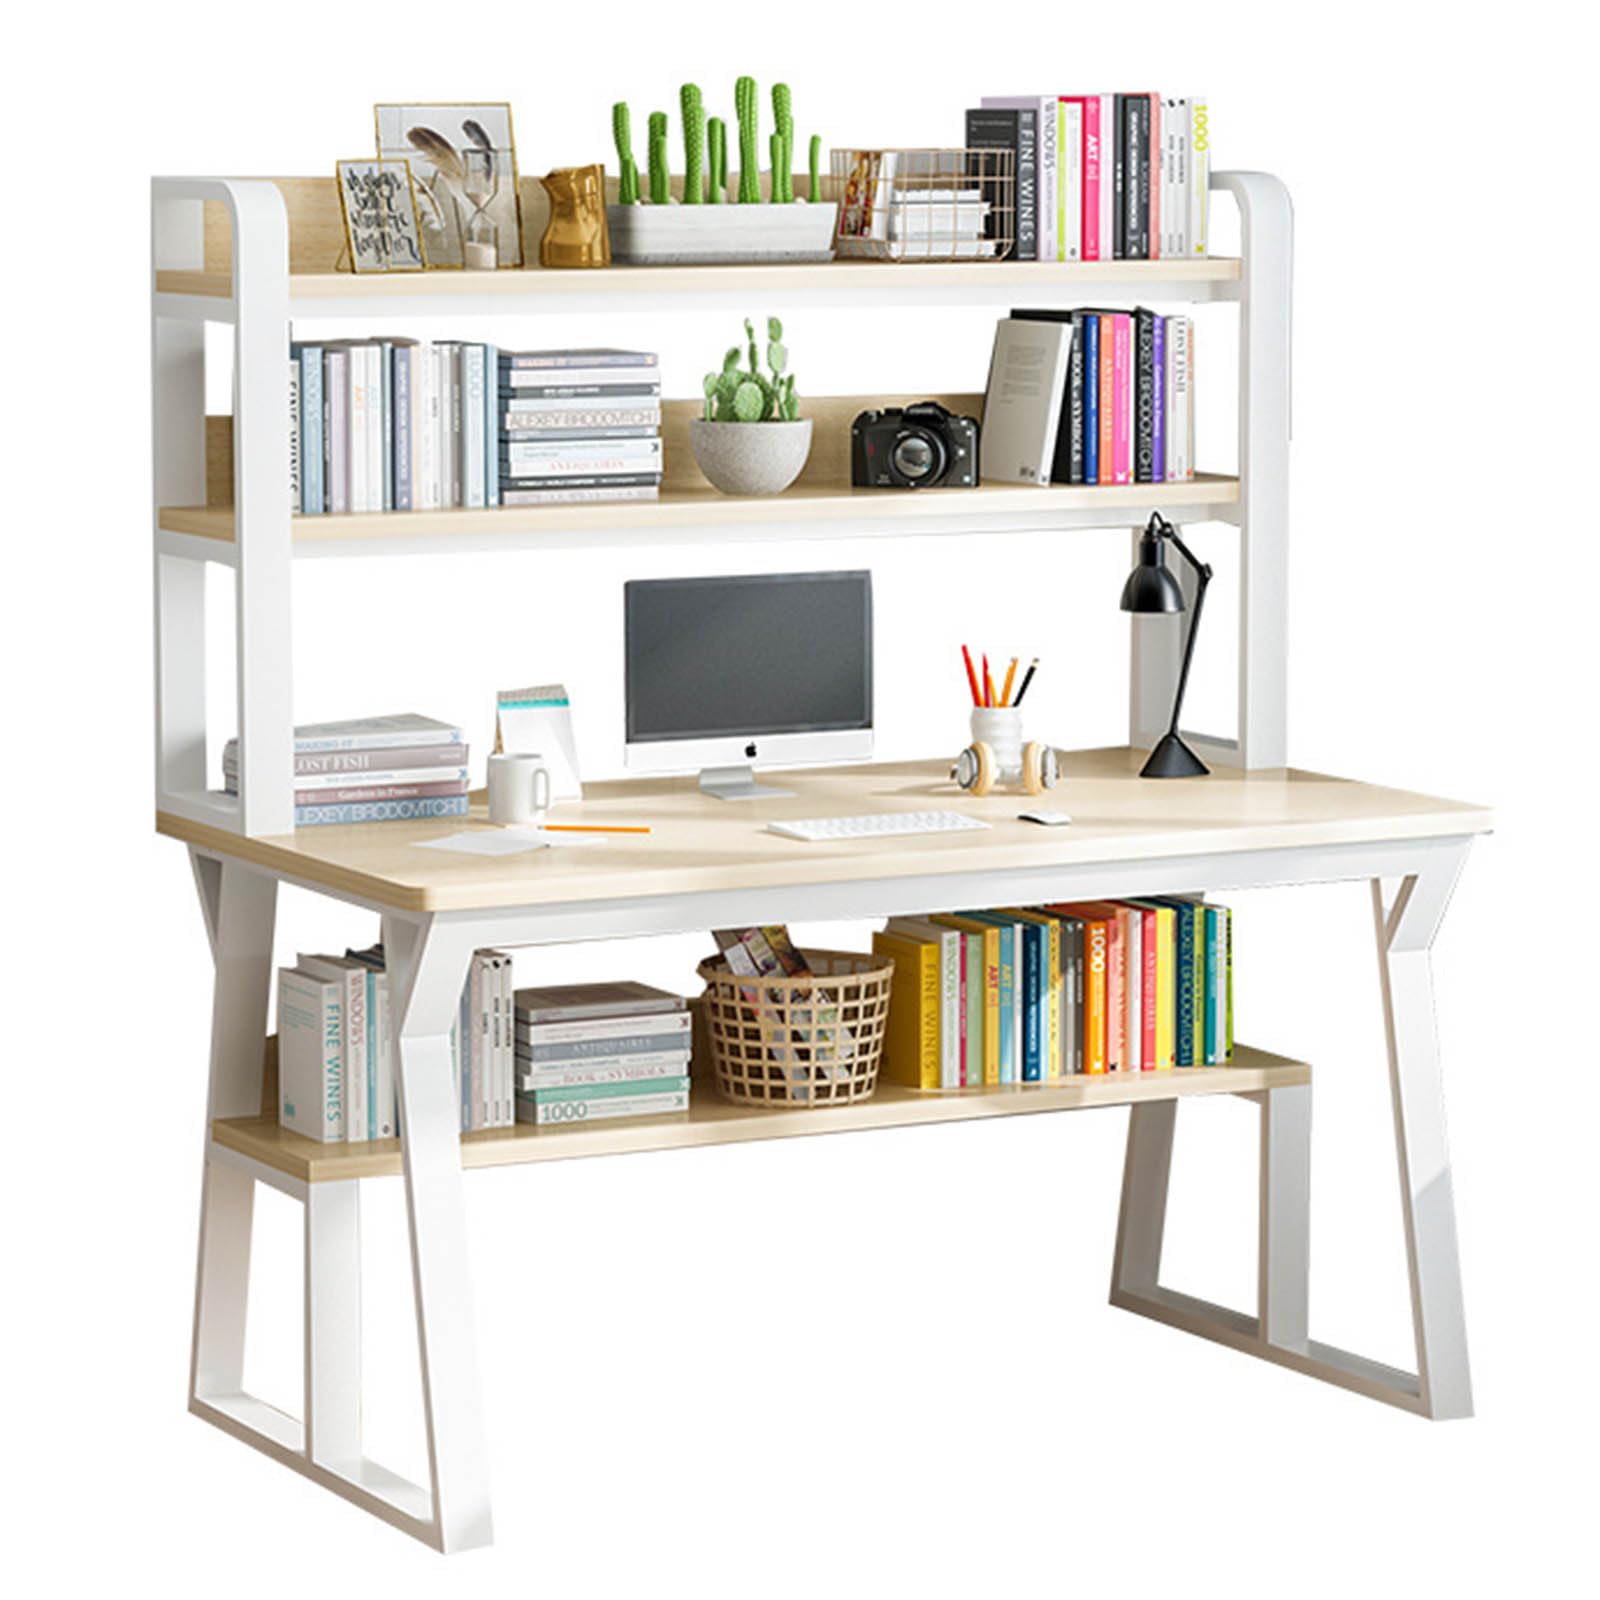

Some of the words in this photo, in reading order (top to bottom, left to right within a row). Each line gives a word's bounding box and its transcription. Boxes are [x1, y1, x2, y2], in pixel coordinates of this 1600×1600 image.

[1087, 134, 1098, 161] ART
[1193, 105, 1208, 152] 1000
[1020, 129, 1034, 171] FINE
[1020, 178, 1034, 242] WINES
[1140, 315, 1151, 374] ALEXEY
[1176, 320, 1186, 357] LOST
[1176, 361, 1186, 393] FISH
[334, 755, 369, 770] FISH
[294, 805, 349, 824] LEXEY
[1092, 927, 1105, 972] 1000
[924, 963, 937, 1005] FINE
[988, 965, 998, 989] ART
[1002, 963, 1012, 989] ART
[327, 1003, 341, 1048] FINE
[351, 974, 364, 1045] WINDOWS
[924, 1010, 937, 1069] WINES
[327, 1056, 341, 1122] WINES
[542, 1102, 588, 1121] 1000
